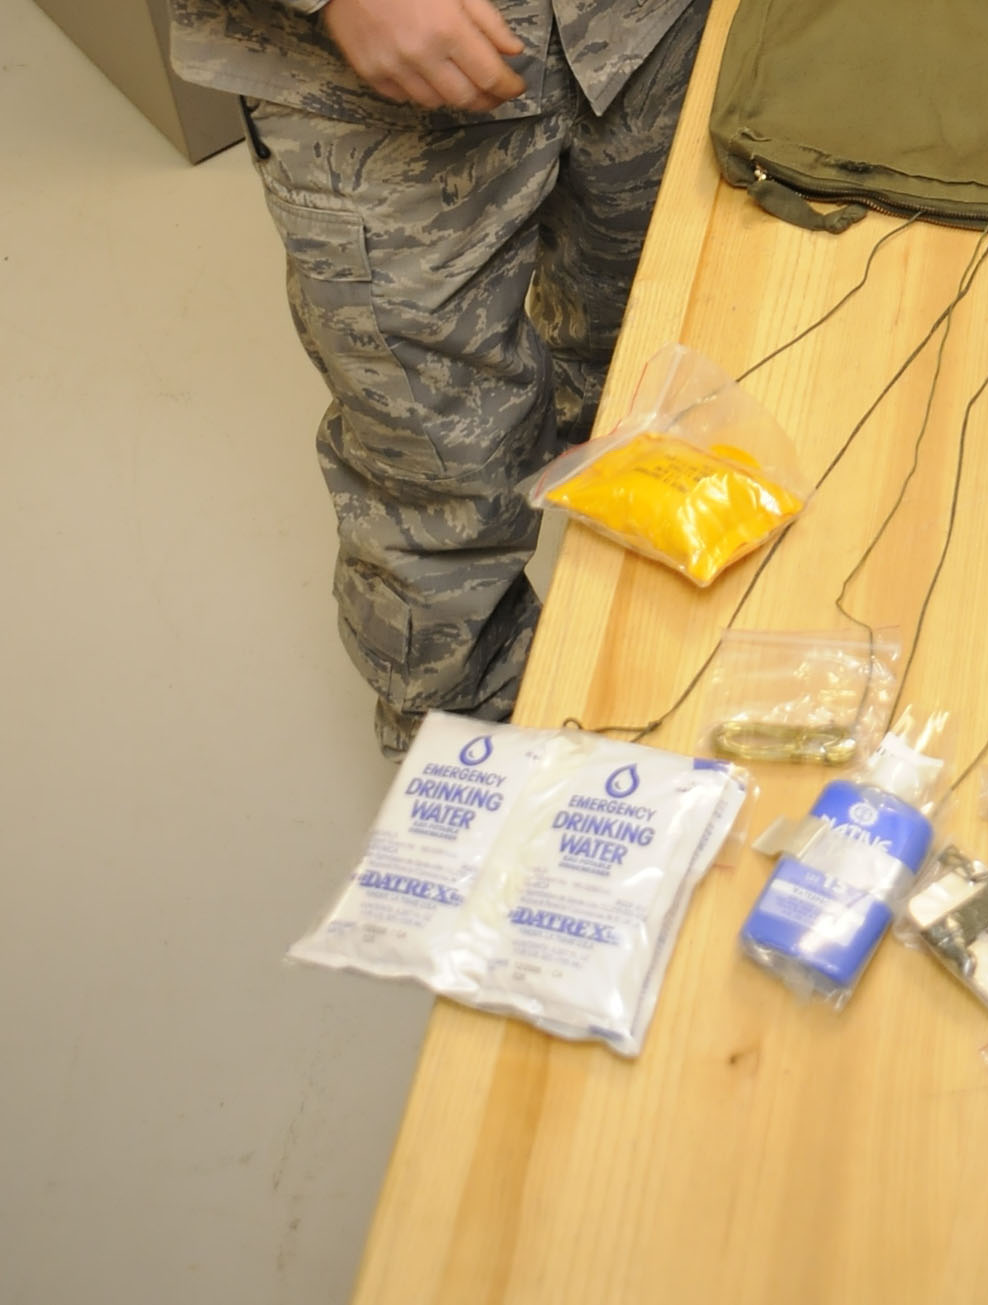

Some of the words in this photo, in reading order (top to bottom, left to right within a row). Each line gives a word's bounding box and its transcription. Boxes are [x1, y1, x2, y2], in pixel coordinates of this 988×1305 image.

[421, 762, 507, 788] EMERGENCY
[404, 776, 505, 812] DRINKING
[567, 794, 657, 822] EMERGENCY
[410, 798, 477, 830] WATER
[551, 810, 656, 847] DRINKING
[559, 832, 629, 865] WATER
